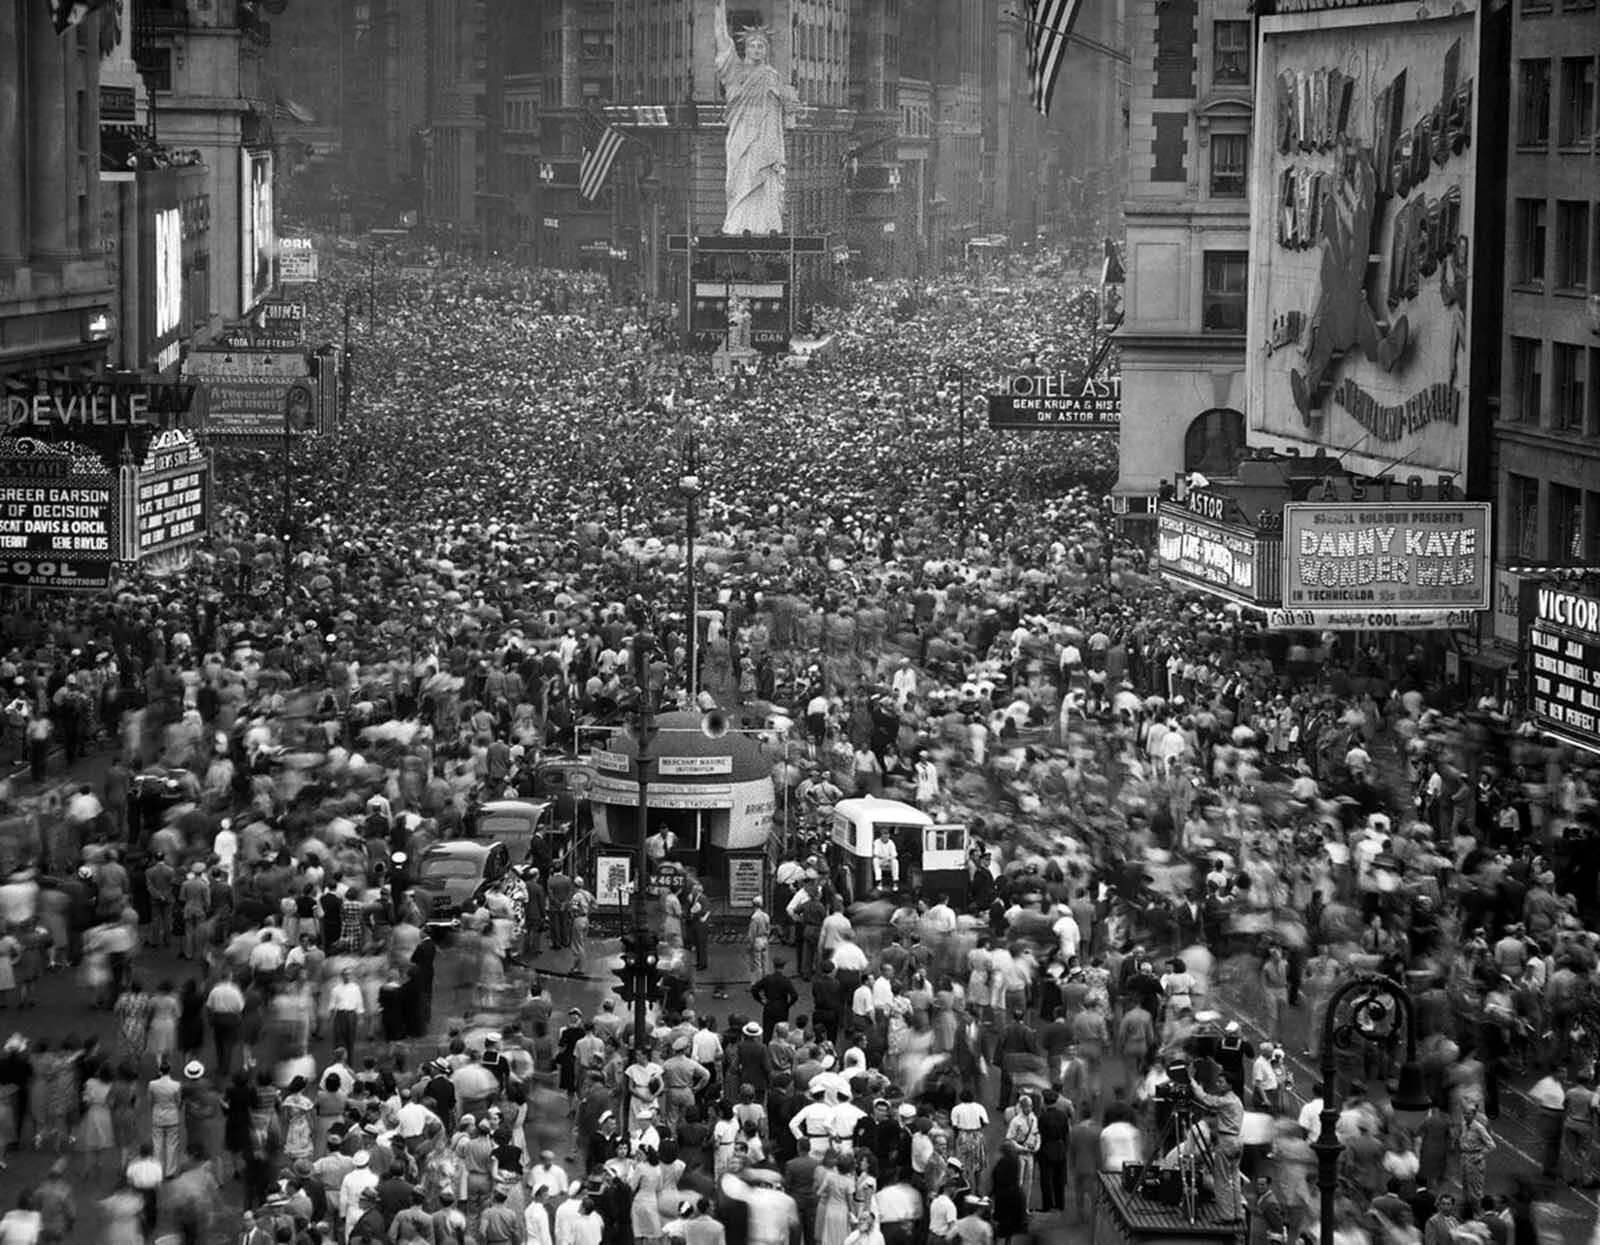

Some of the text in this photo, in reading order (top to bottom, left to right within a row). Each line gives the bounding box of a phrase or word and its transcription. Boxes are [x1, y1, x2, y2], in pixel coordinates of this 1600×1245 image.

[755, 334, 784, 342] LOAN
[999, 375, 1121, 398] HOTEL AST
[7, 395, 148, 425] DEVILLE
[1012, 399, 1041, 409] GENE
[1044, 400, 1081, 410] KRUPA
[1095, 401, 1113, 410] HIS
[1037, 412, 1052, 421] ON
[1058, 412, 1094, 421] ASTOR
[1320, 475, 1455, 500] ASTOR
[50, 489, 110, 503] GARSON
[8, 504, 28, 517] OF
[1190, 492, 1223, 520] ASTOR
[24, 520, 60, 534] DAVIS
[62, 521, 70, 534] &
[71, 521, 108, 534] ORCH.
[1300, 527, 1476, 557] DANNY KAYE
[1299, 556, 1475, 587] WONDER MAN
[1538, 589, 1598, 632] VICTOR
[1368, 613, 1399, 627] COOL
[659, 876, 672, 886] 46
[672, 876, 684, 886] ST
